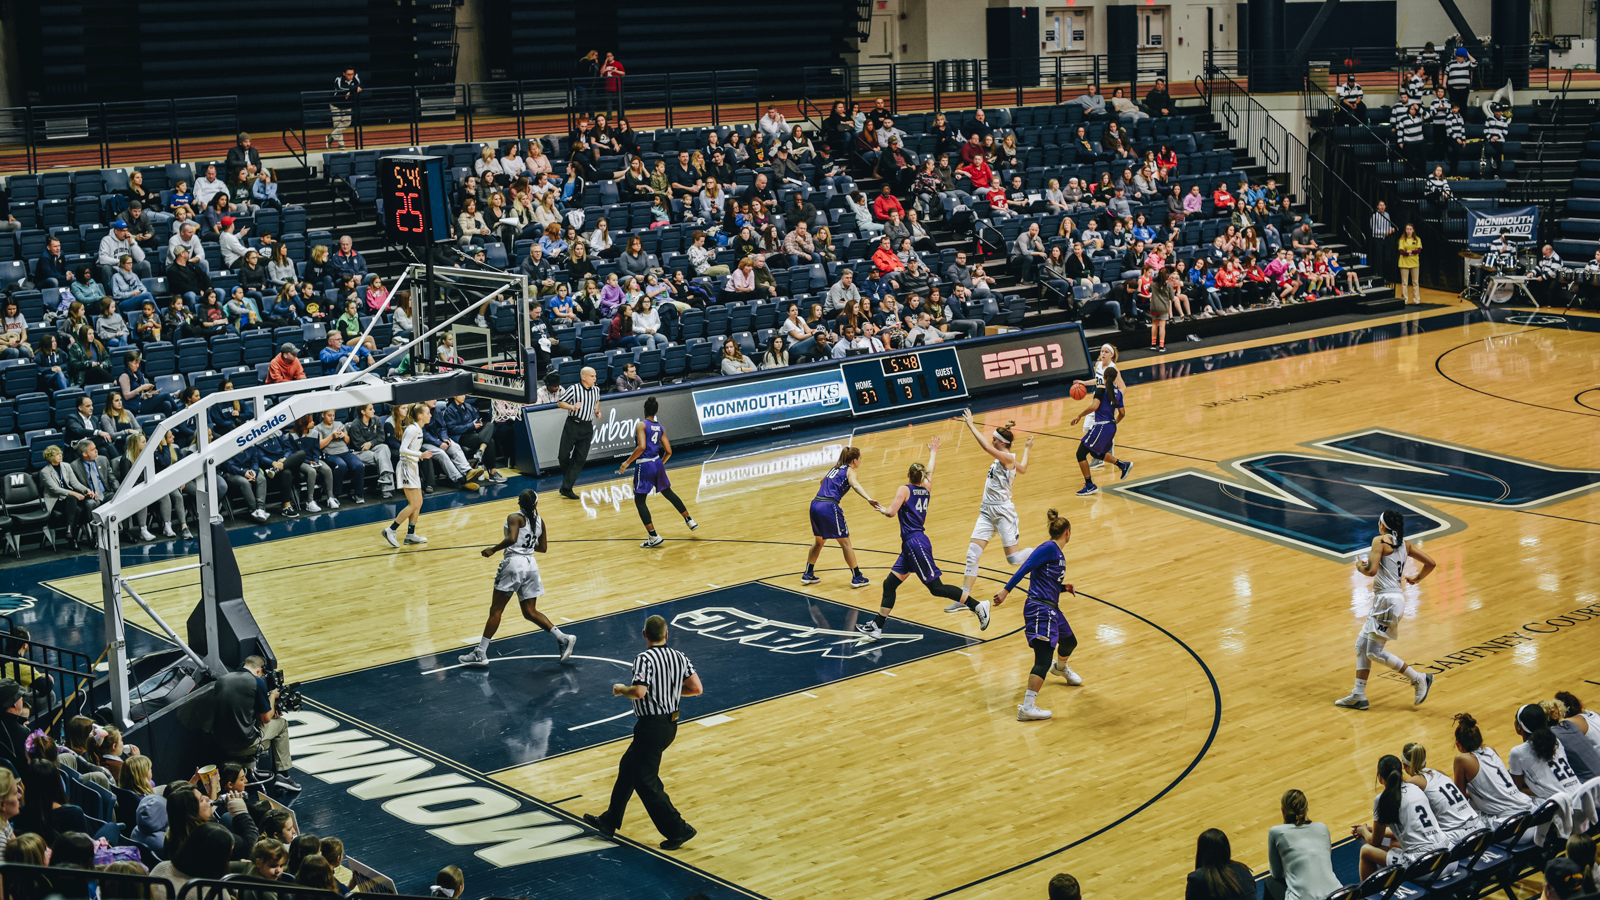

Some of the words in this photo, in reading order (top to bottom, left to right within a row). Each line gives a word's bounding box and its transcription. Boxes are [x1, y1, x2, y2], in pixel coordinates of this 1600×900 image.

[395, 191, 424, 233] 25
[1475, 215, 1535, 227] MONMOUTH
[1474, 226, 1497, 235] PEP
[1499, 224, 1531, 234] AND
[890, 355, 918, 372] 5:48
[935, 367, 954, 377] GUEST
[855, 380, 873, 391] HOME
[897, 377, 914, 385] PERIOD
[942, 376, 958, 390] 43
[861, 390, 878, 405] 37
[904, 385, 913, 399] 3
[236, 413, 287, 447] Schelde
[651, 432, 659, 444] 4
[10, 474, 25, 486] M
[826, 468, 839, 479] 10
[914, 498, 928, 513] 44
[1548, 757, 1576, 782] 22
[1496, 767, 1513, 789] 1
[1438, 782, 1465, 806] 12
[1415, 805, 1433, 828] 2
